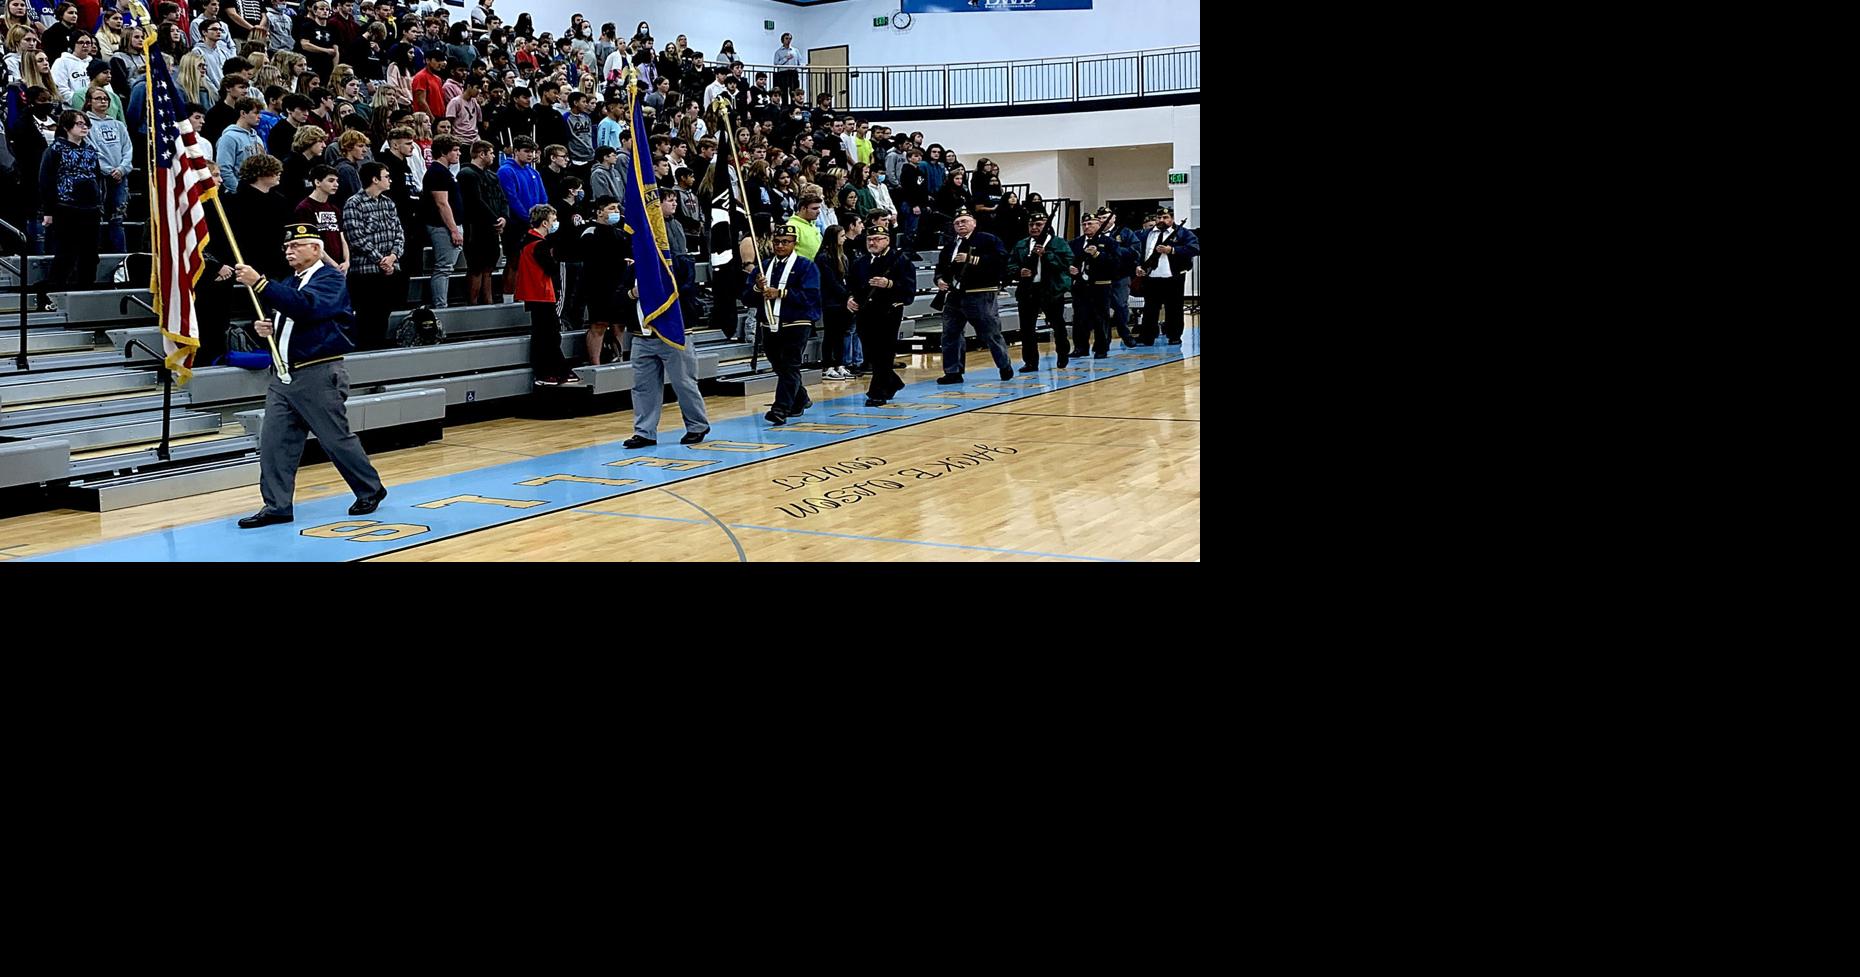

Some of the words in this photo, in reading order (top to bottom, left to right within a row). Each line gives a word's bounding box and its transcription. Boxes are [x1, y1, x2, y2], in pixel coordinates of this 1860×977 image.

[771, 455, 887, 492] COURT
[925, 444, 1018, 472] JACK
[299, 440, 793, 542] DELLS
[774, 479, 905, 519] OLSON
